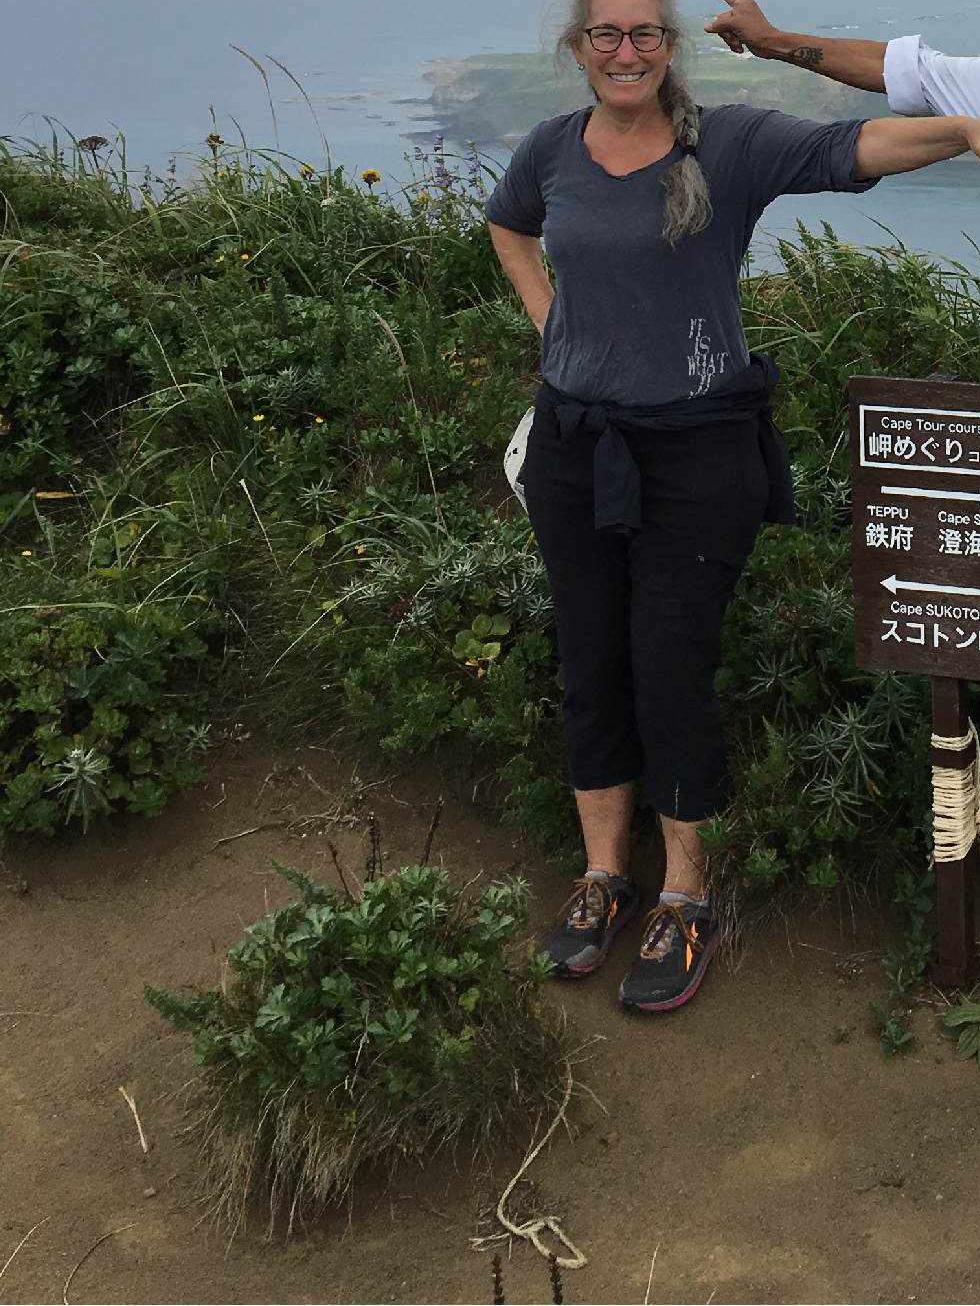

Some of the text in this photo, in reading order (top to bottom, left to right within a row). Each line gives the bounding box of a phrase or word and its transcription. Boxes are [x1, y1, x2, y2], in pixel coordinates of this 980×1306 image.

[694, 335, 711, 356] IS
[687, 351, 729, 376] WHAT
[881, 416, 912, 431] Cape
[916, 418, 945, 431] Tour
[866, 505, 909, 520] TEPPU
[938, 510, 970, 526] Cape
[865, 522, 913, 551] 鉄府
[890, 600, 922, 615] Cape
